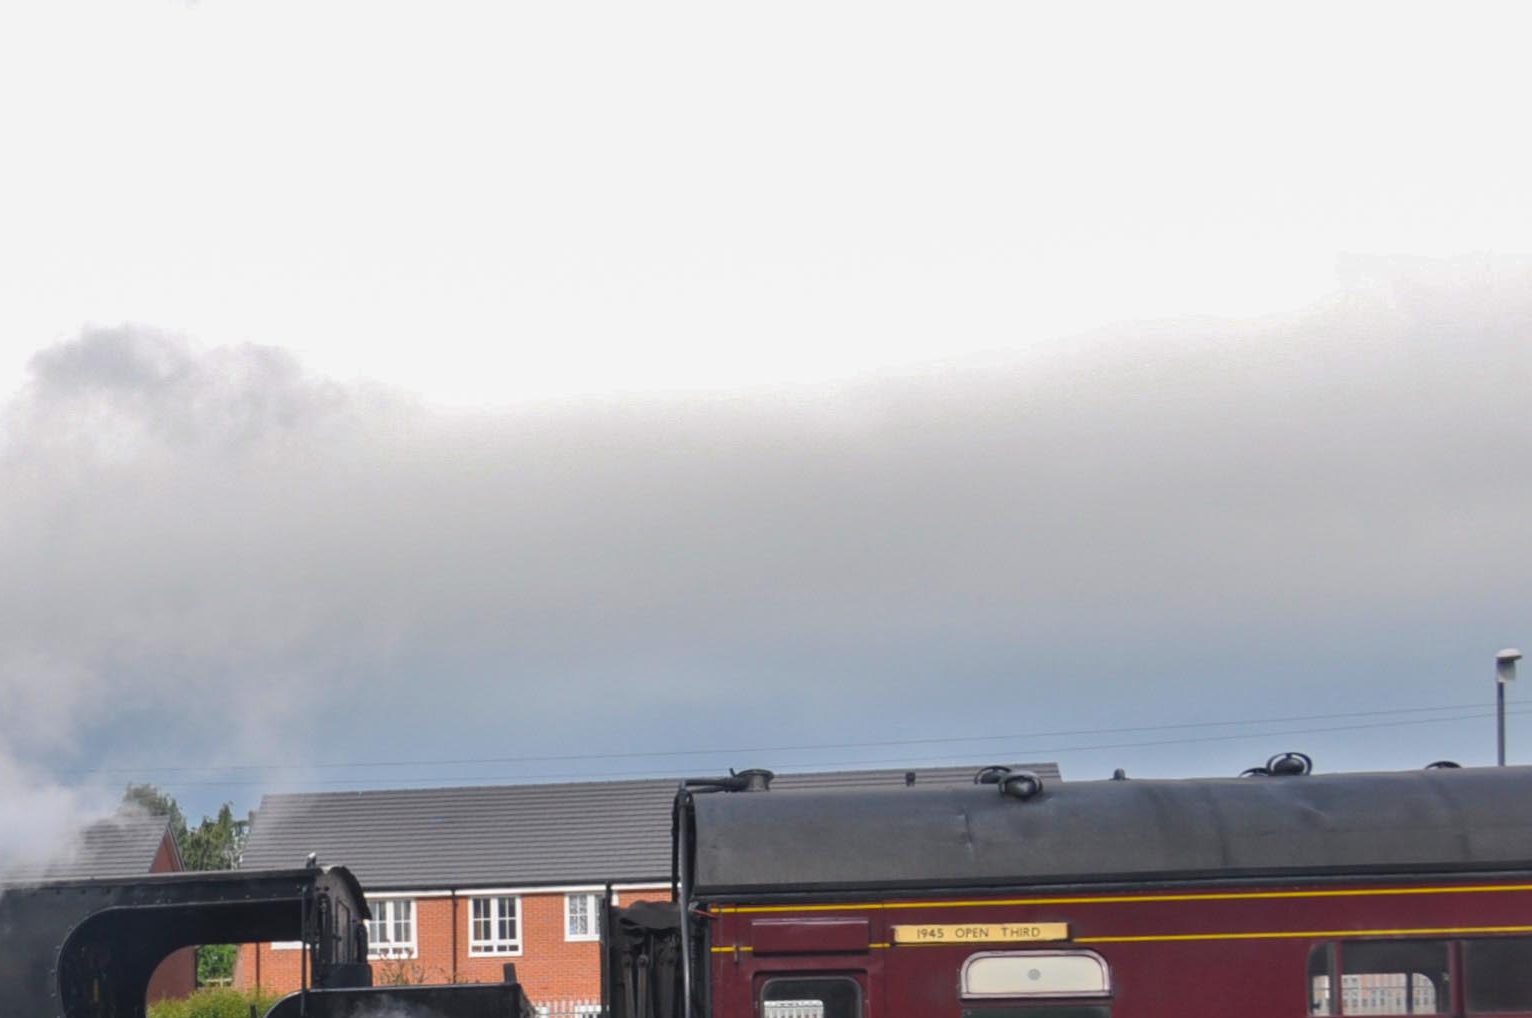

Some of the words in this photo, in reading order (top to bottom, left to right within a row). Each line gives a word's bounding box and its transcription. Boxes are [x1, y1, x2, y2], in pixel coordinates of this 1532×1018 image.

[917, 928, 944, 939] 1945
[955, 927, 989, 938] OPEN
[1001, 926, 1041, 938] THIRD
